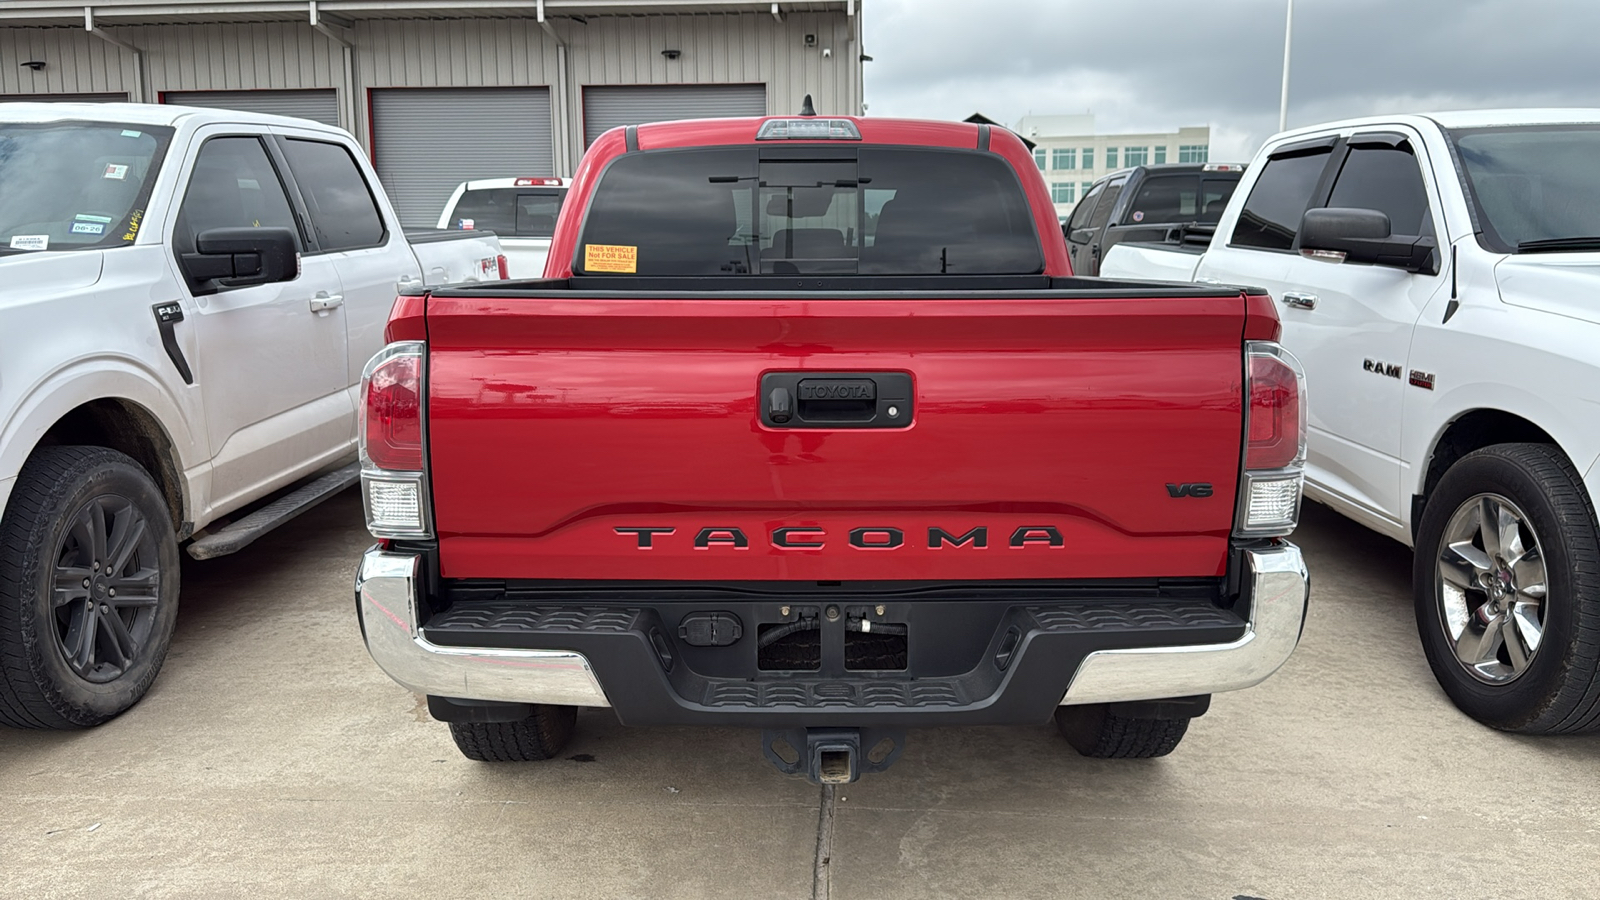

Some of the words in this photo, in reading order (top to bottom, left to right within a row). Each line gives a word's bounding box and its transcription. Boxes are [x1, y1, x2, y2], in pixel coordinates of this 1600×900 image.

[1363, 358, 1402, 380] RAM
[805, 384, 871, 399] TOYOTA
[1165, 482, 1213, 498] V6
[613, 526, 1066, 551] TACOMA
